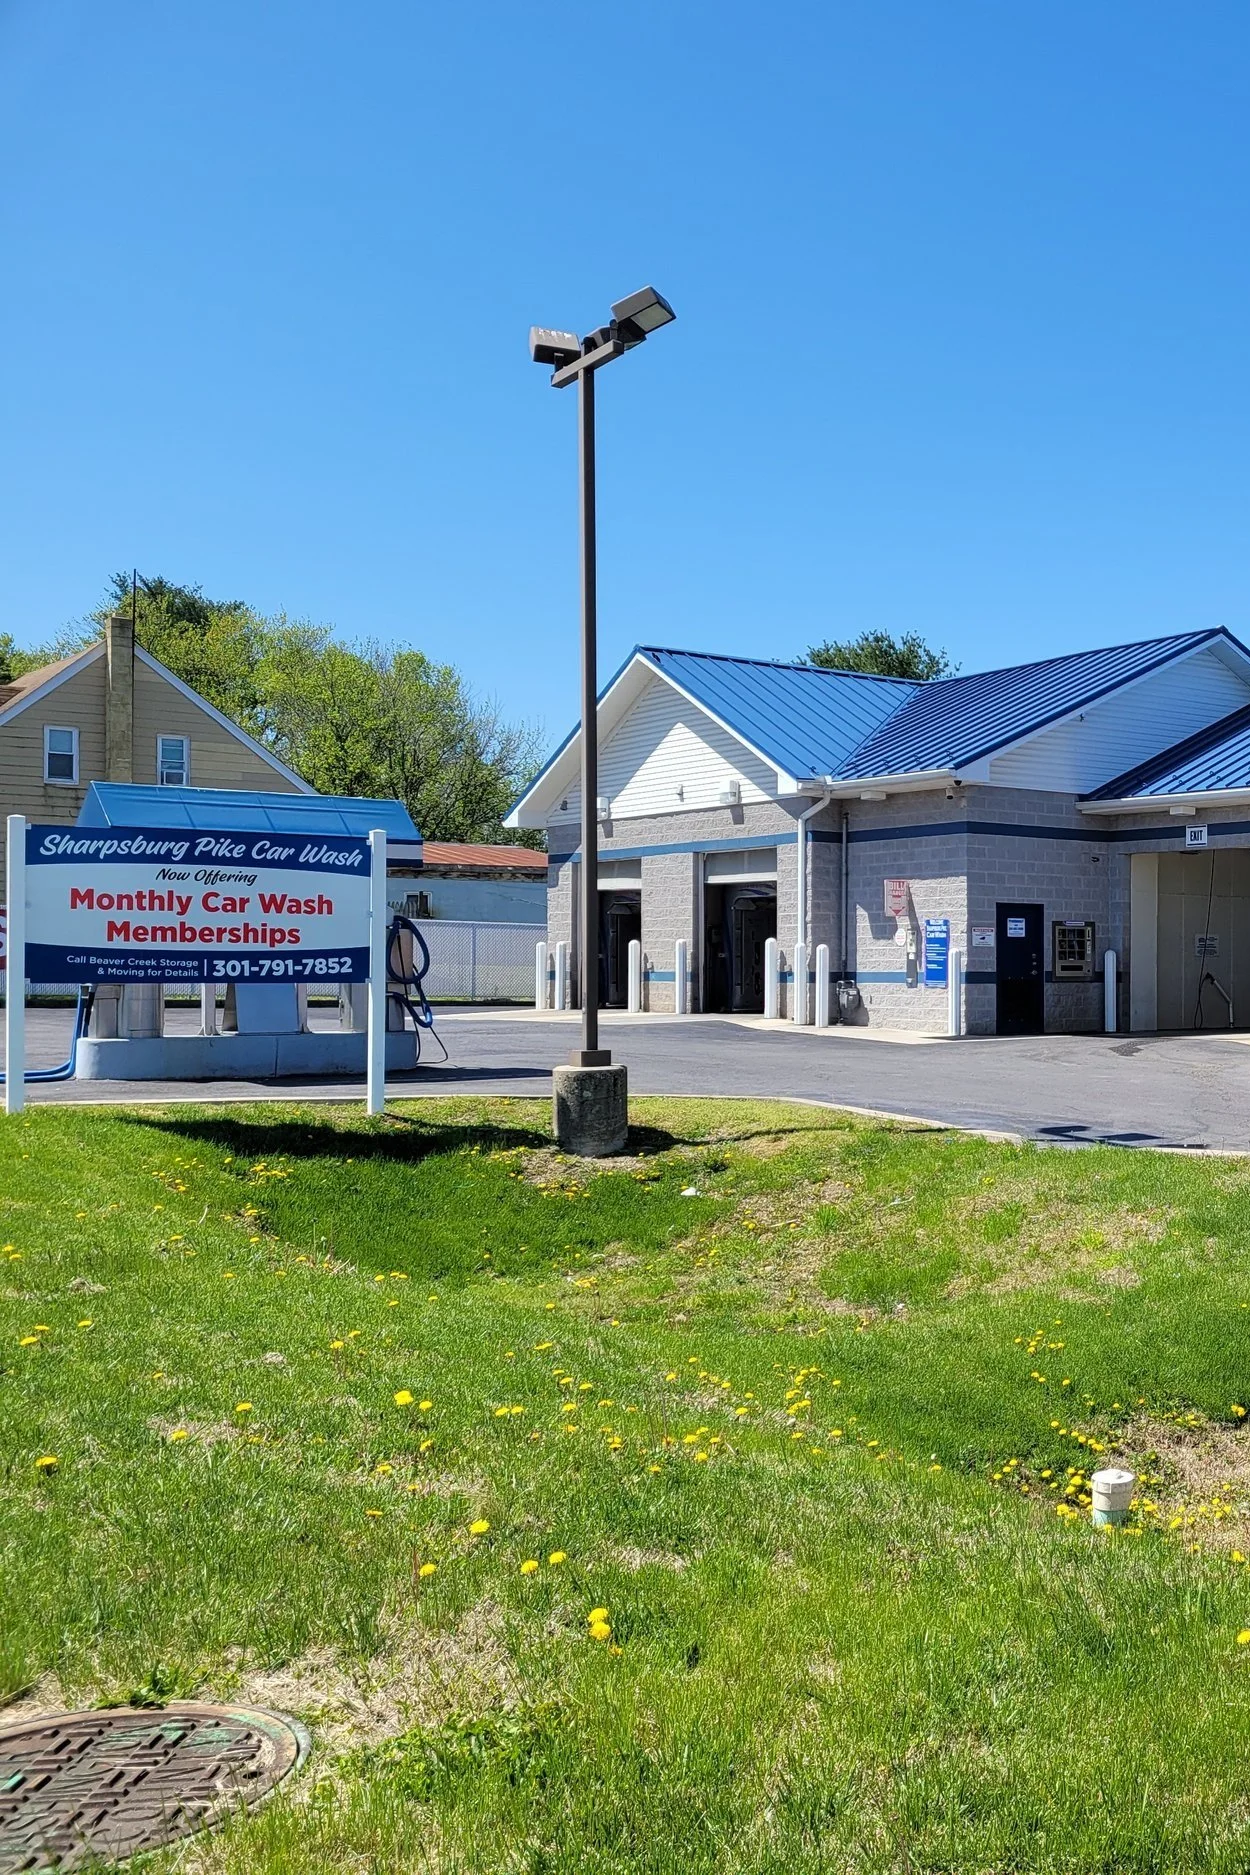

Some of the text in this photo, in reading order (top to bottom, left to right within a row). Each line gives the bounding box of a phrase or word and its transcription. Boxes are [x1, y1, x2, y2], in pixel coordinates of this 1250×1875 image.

[1189, 829, 1203, 842] EXIT
[39, 834, 364, 867] Sharpsburg Pike Car Wash
[155, 868, 258, 887] Now Offering
[70, 887, 333, 917] Monthly Car Wash
[106, 920, 302, 948] Memberships
[66, 955, 199, 968] Call Beaver Creek Storage
[97, 966, 199, 978] & Moving for Details
[212, 956, 353, 977] 301-791-7852
[0, 1722, 162, 1867] ASHINGTON
